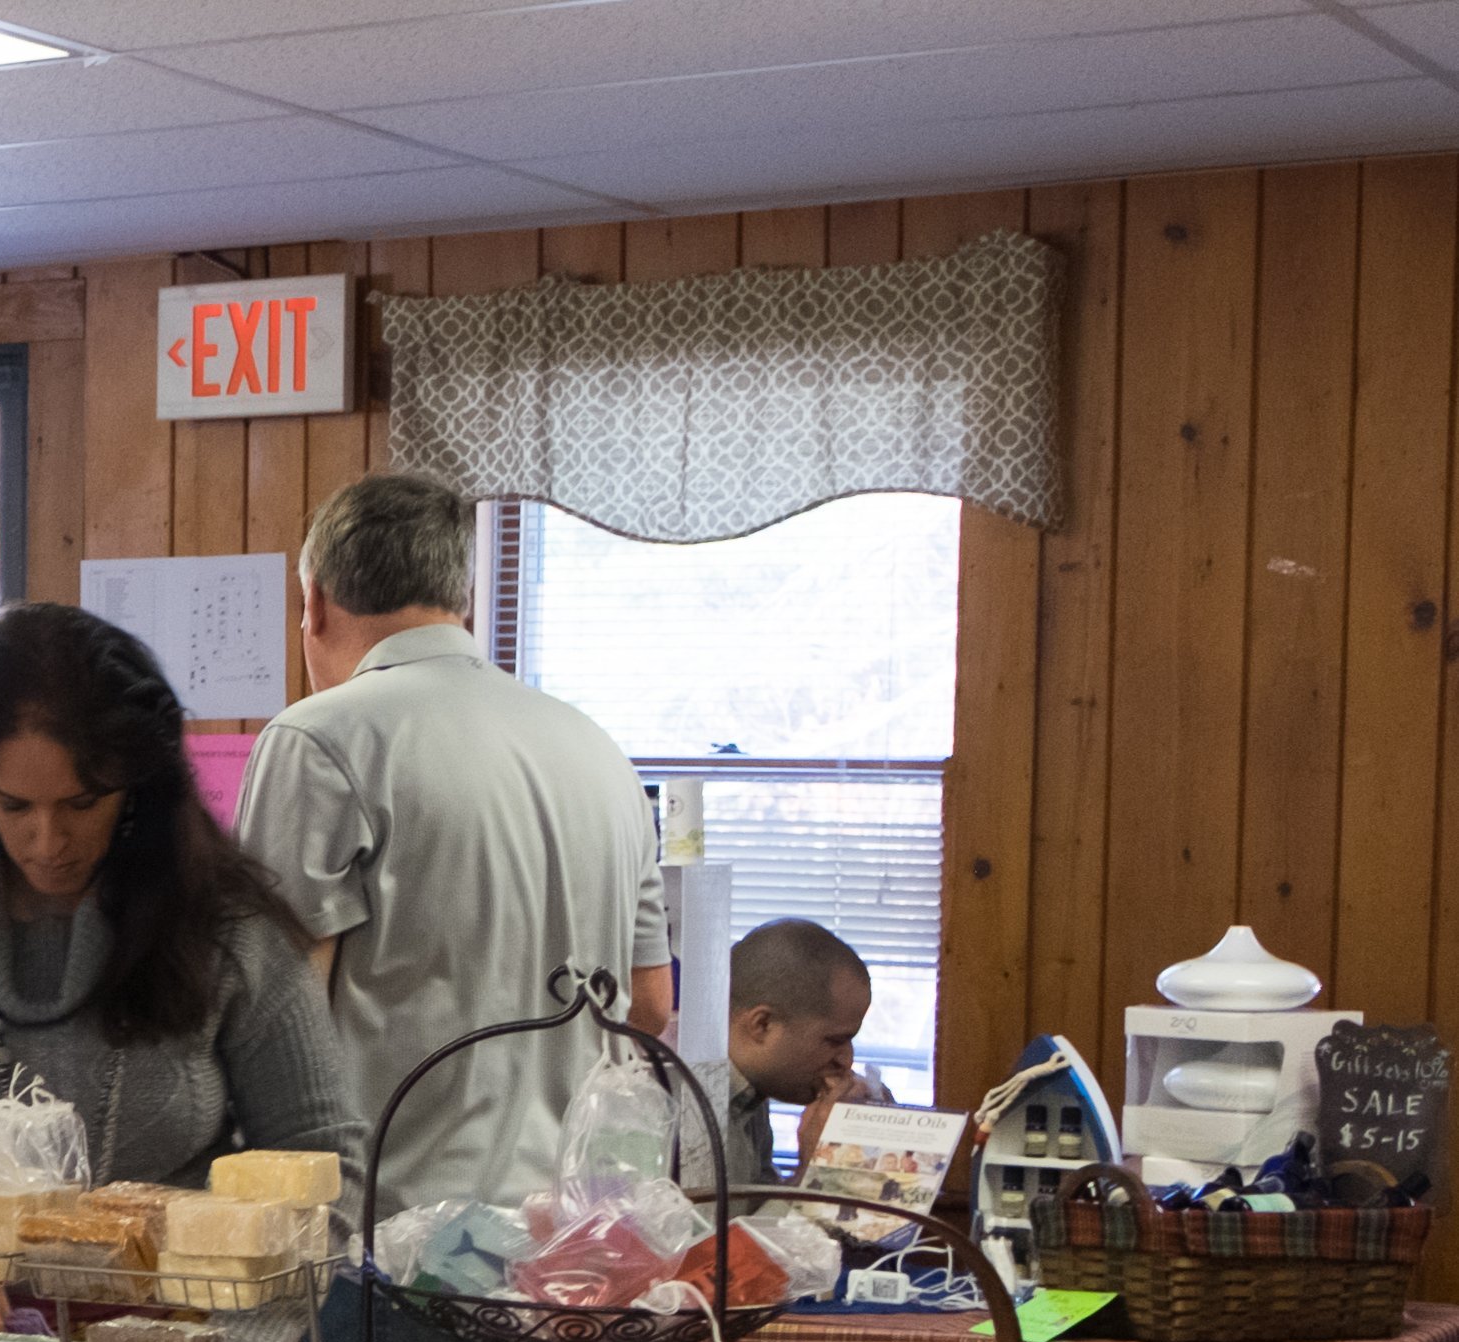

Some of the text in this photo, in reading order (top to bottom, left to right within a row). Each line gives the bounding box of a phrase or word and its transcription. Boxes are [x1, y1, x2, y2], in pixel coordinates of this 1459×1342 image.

[191, 296, 318, 397] EXIT
[1341, 1087, 1424, 1116] SALE
[843, 1107, 948, 1129] Essential Oils
